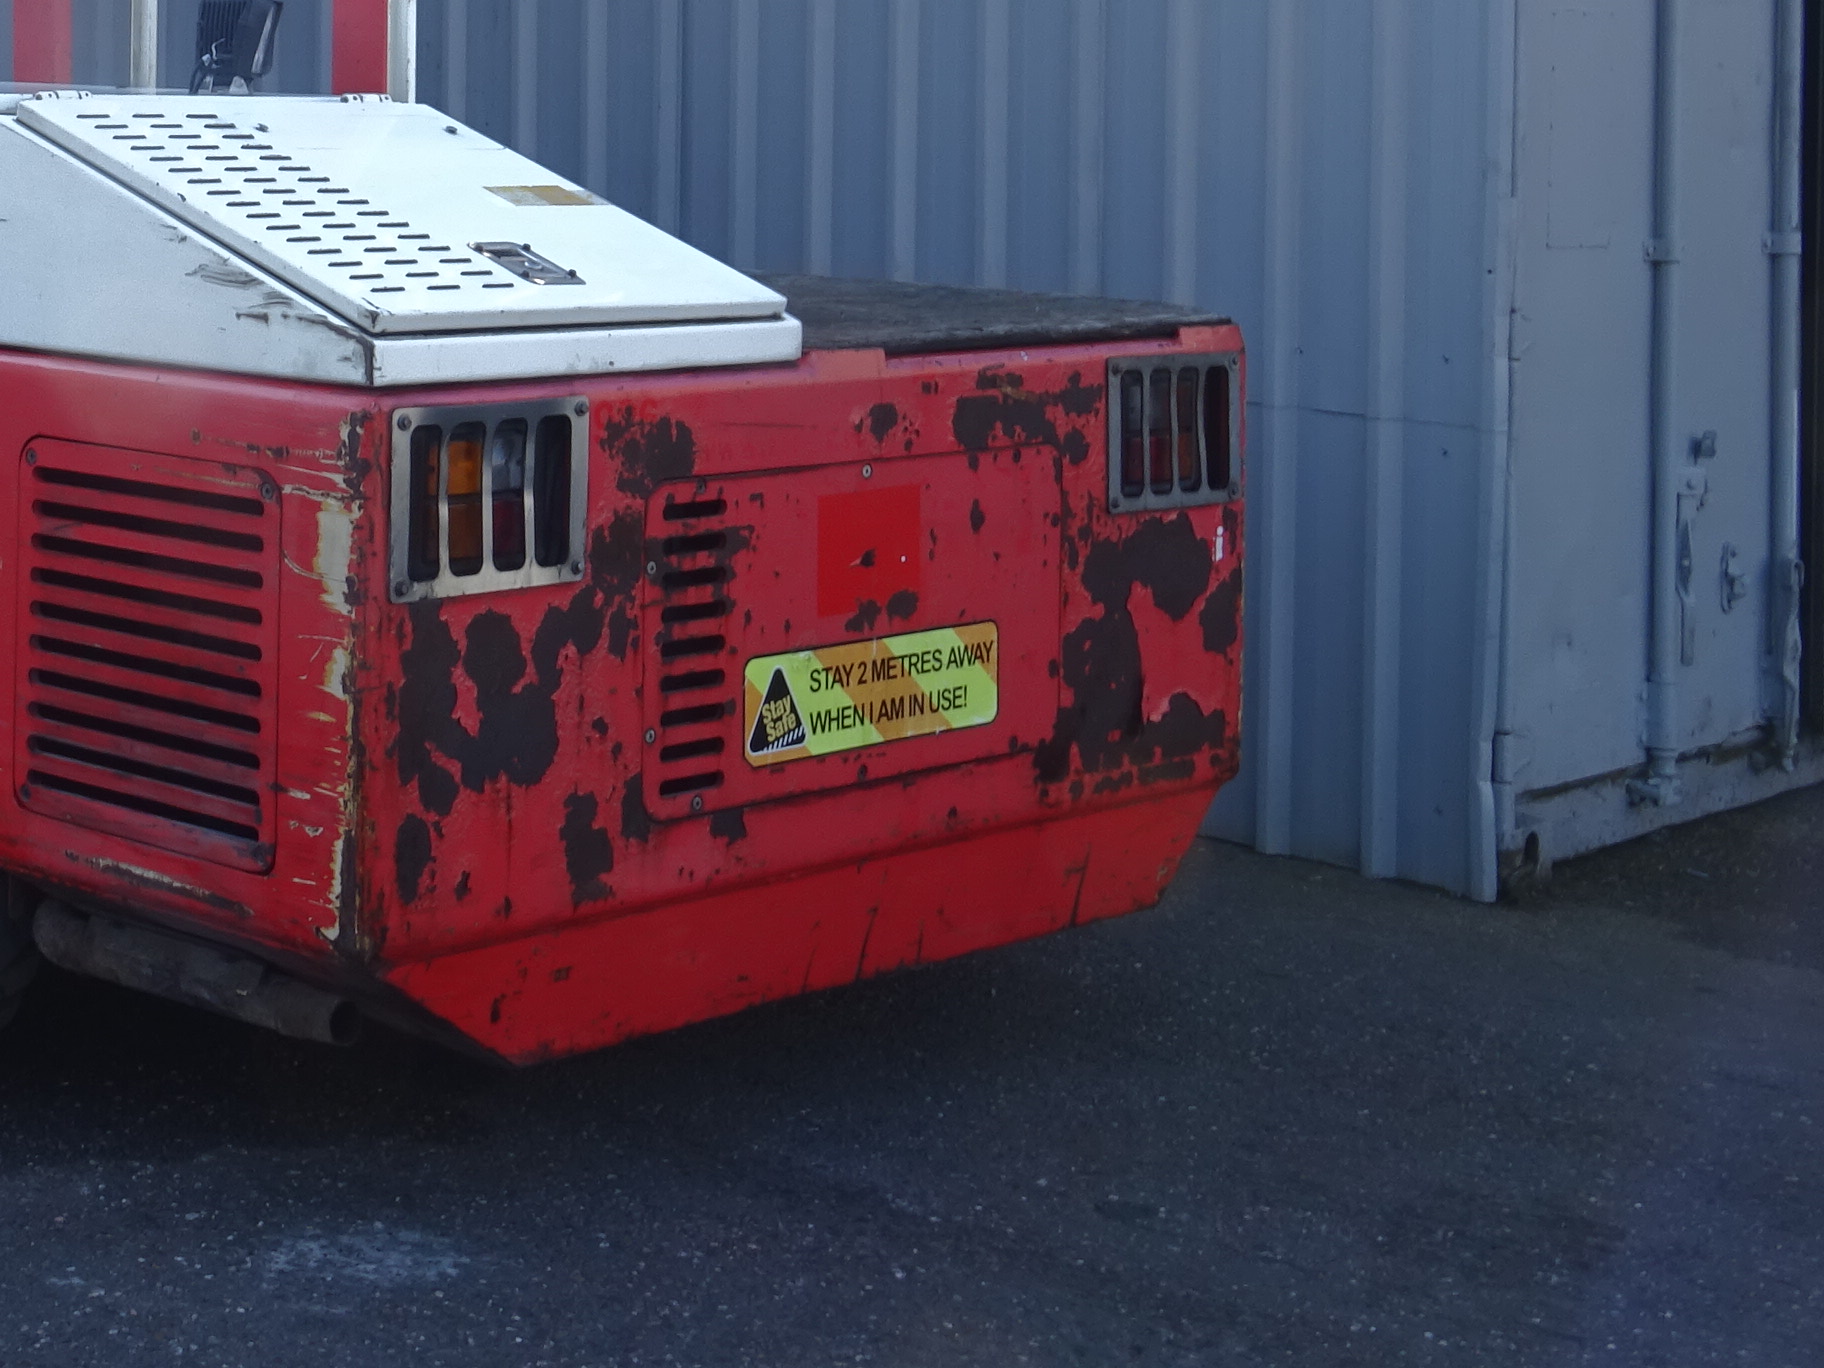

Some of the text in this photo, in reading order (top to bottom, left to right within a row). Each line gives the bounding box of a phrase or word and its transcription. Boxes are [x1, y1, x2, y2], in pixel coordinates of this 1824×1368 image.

[809, 640, 994, 692] STAY 2 METRES AWAY
[761, 694, 792, 725] Stay
[766, 712, 797, 743] Safe
[809, 703, 865, 735] WHEN
[877, 697, 905, 724] AM
[908, 693, 925, 721] IN
[929, 685, 968, 714] USE!
